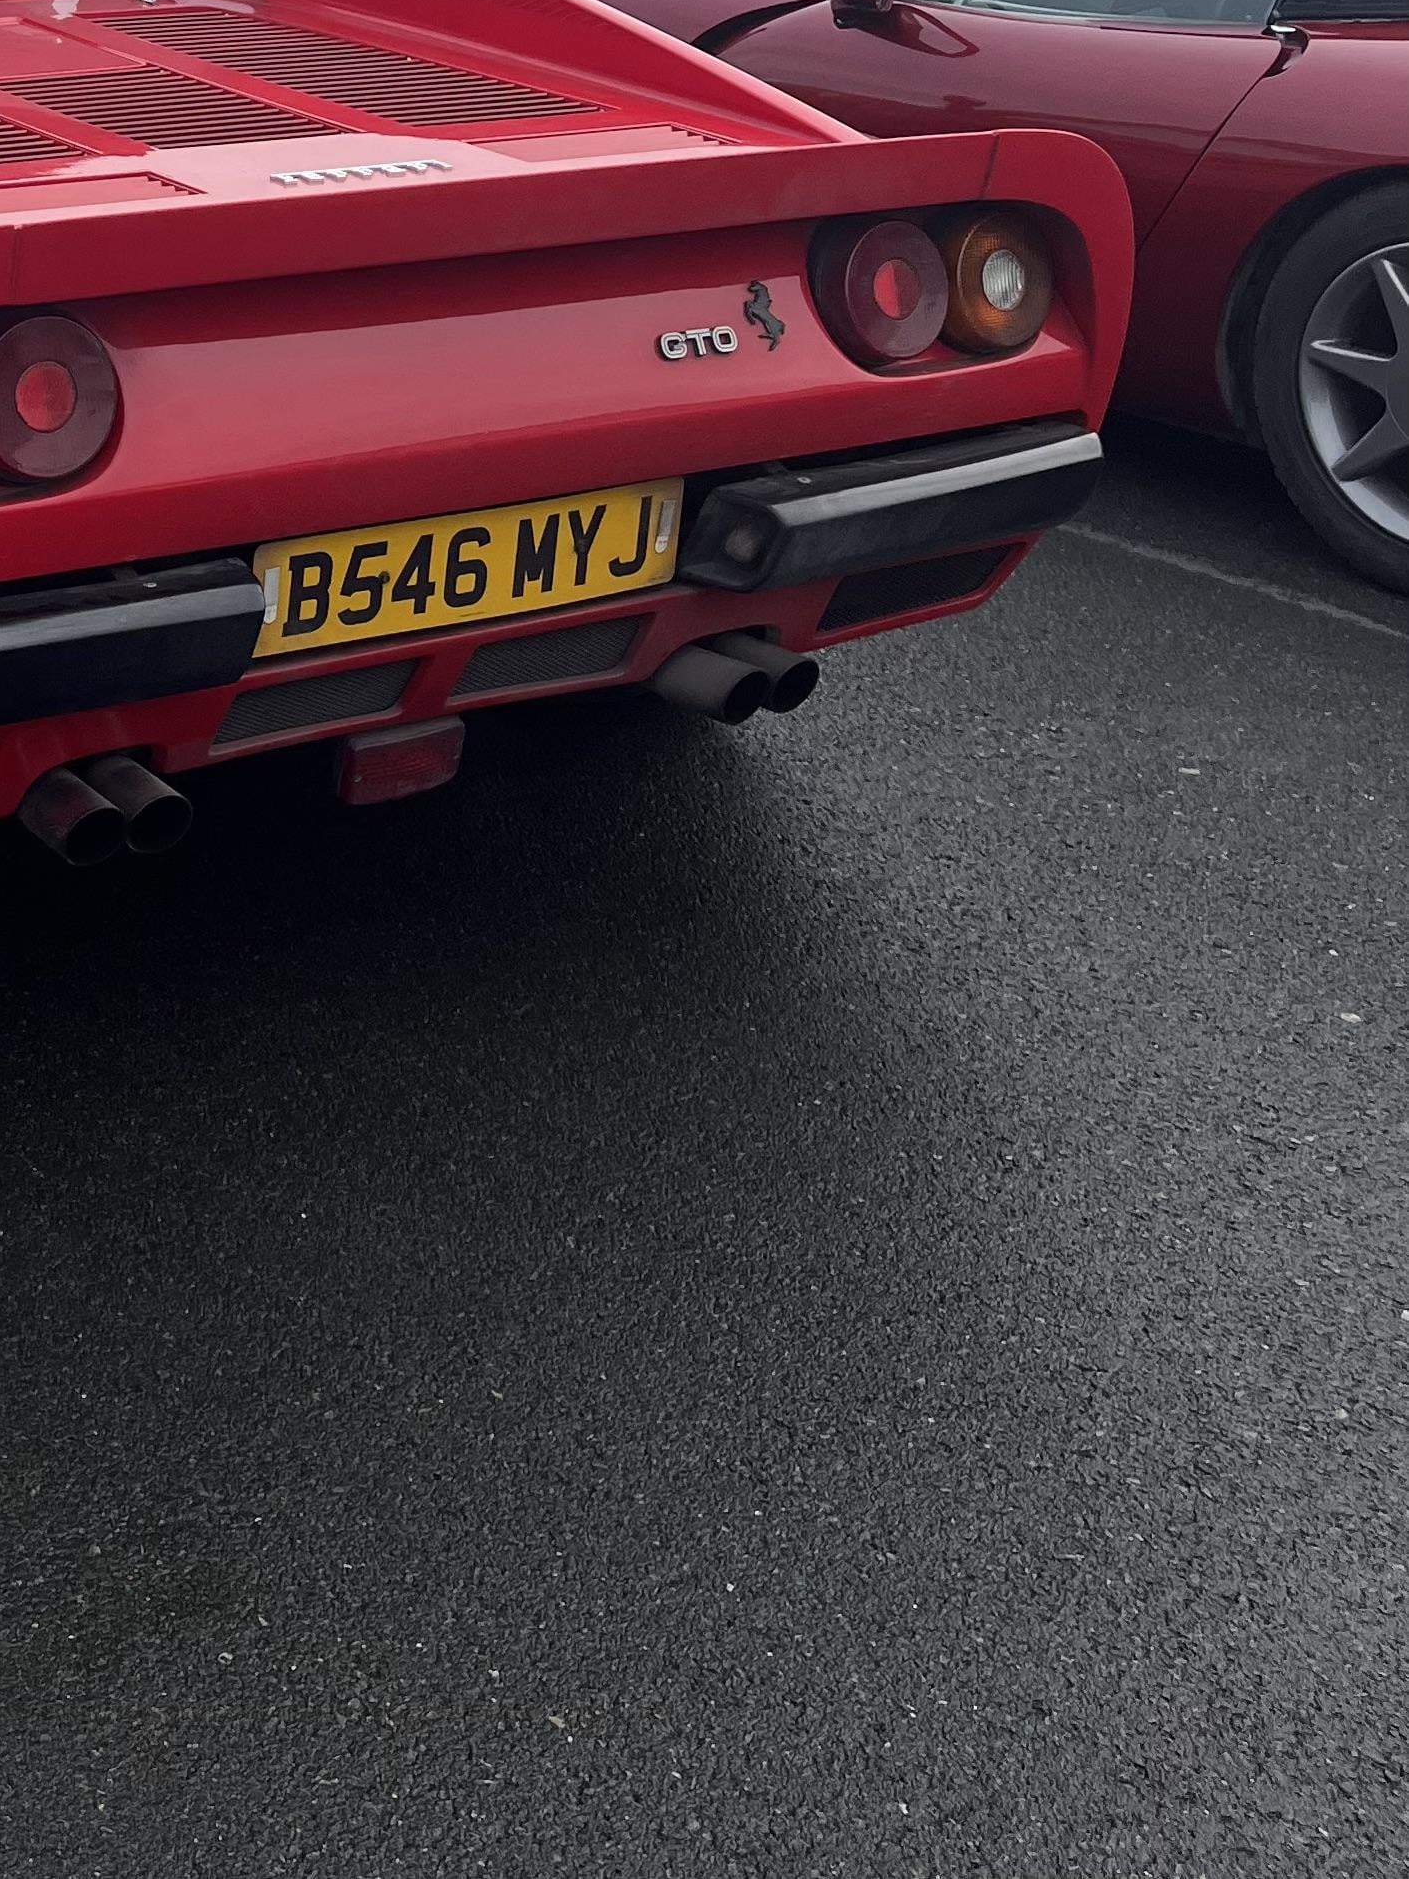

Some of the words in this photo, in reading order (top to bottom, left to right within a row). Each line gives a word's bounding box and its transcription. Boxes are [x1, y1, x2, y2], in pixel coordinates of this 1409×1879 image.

[657, 325, 739, 361] GTO
[281, 527, 491, 639] B546
[511, 496, 653, 599] MYJ
